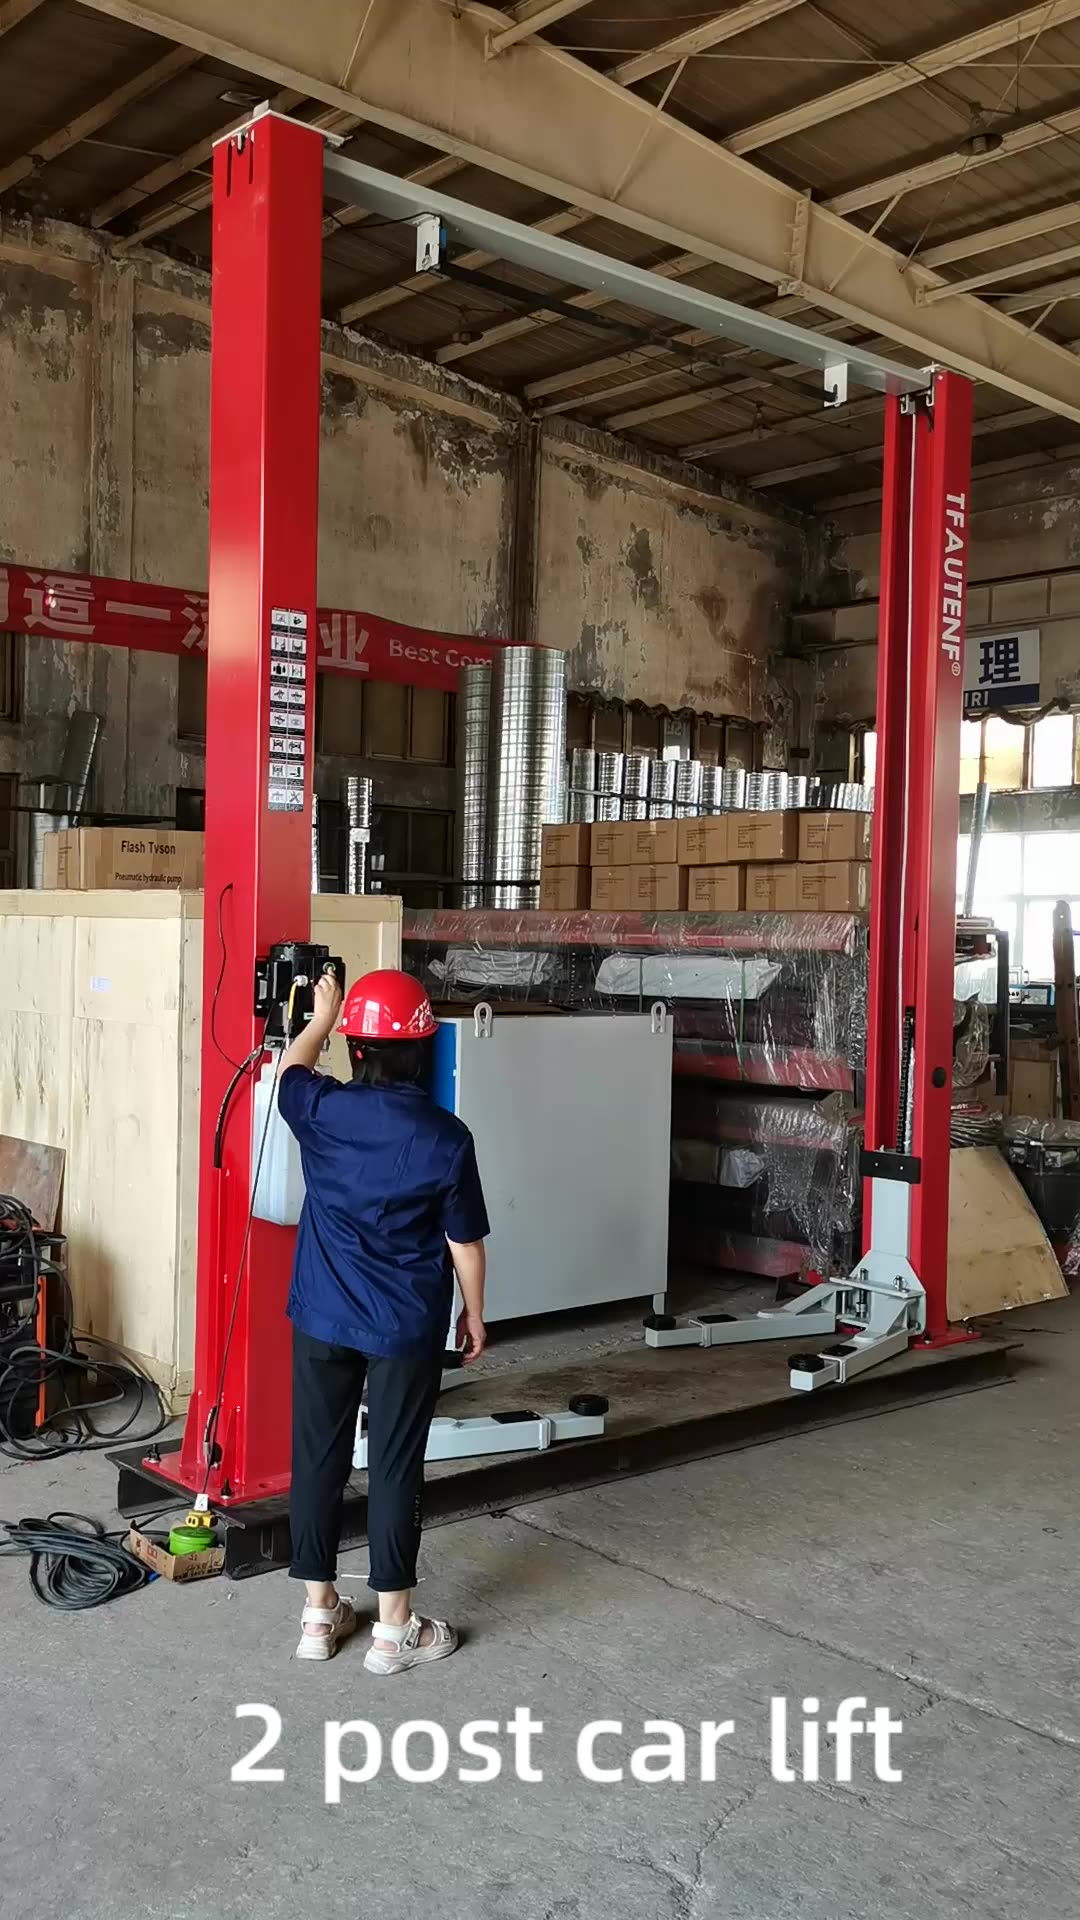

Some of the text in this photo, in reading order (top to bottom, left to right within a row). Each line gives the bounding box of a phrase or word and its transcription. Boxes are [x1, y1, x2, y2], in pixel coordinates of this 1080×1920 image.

[317, 613, 370, 672] 业
[389, 639, 440, 665] Best
[978, 637, 1021, 685] 理
[121, 840, 146, 854] Flash
